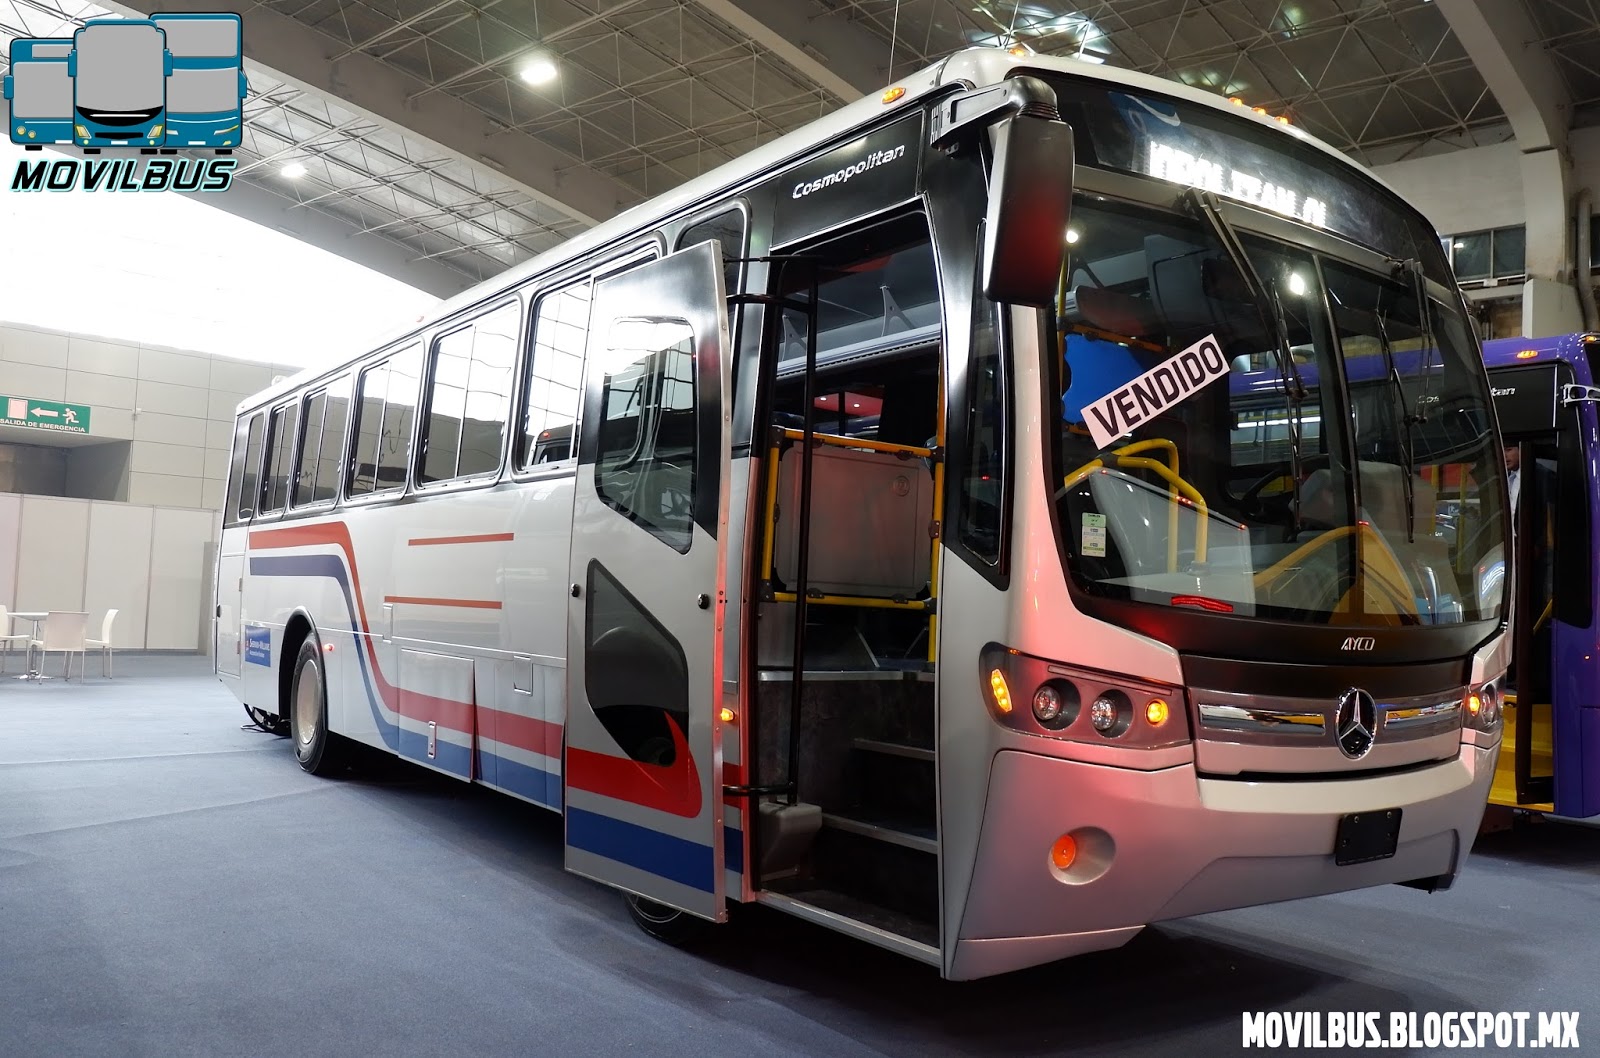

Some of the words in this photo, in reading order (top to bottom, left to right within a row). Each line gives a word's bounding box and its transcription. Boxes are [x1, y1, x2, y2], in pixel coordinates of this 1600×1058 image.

[792, 144, 905, 199] Cosmopolitan
[1090, 341, 1224, 438] VENDIDO
[0, 418, 27, 427] SALIDA
[40, 422, 86, 433] EMERGENCIA
[1341, 636, 1376, 650] AYCO
